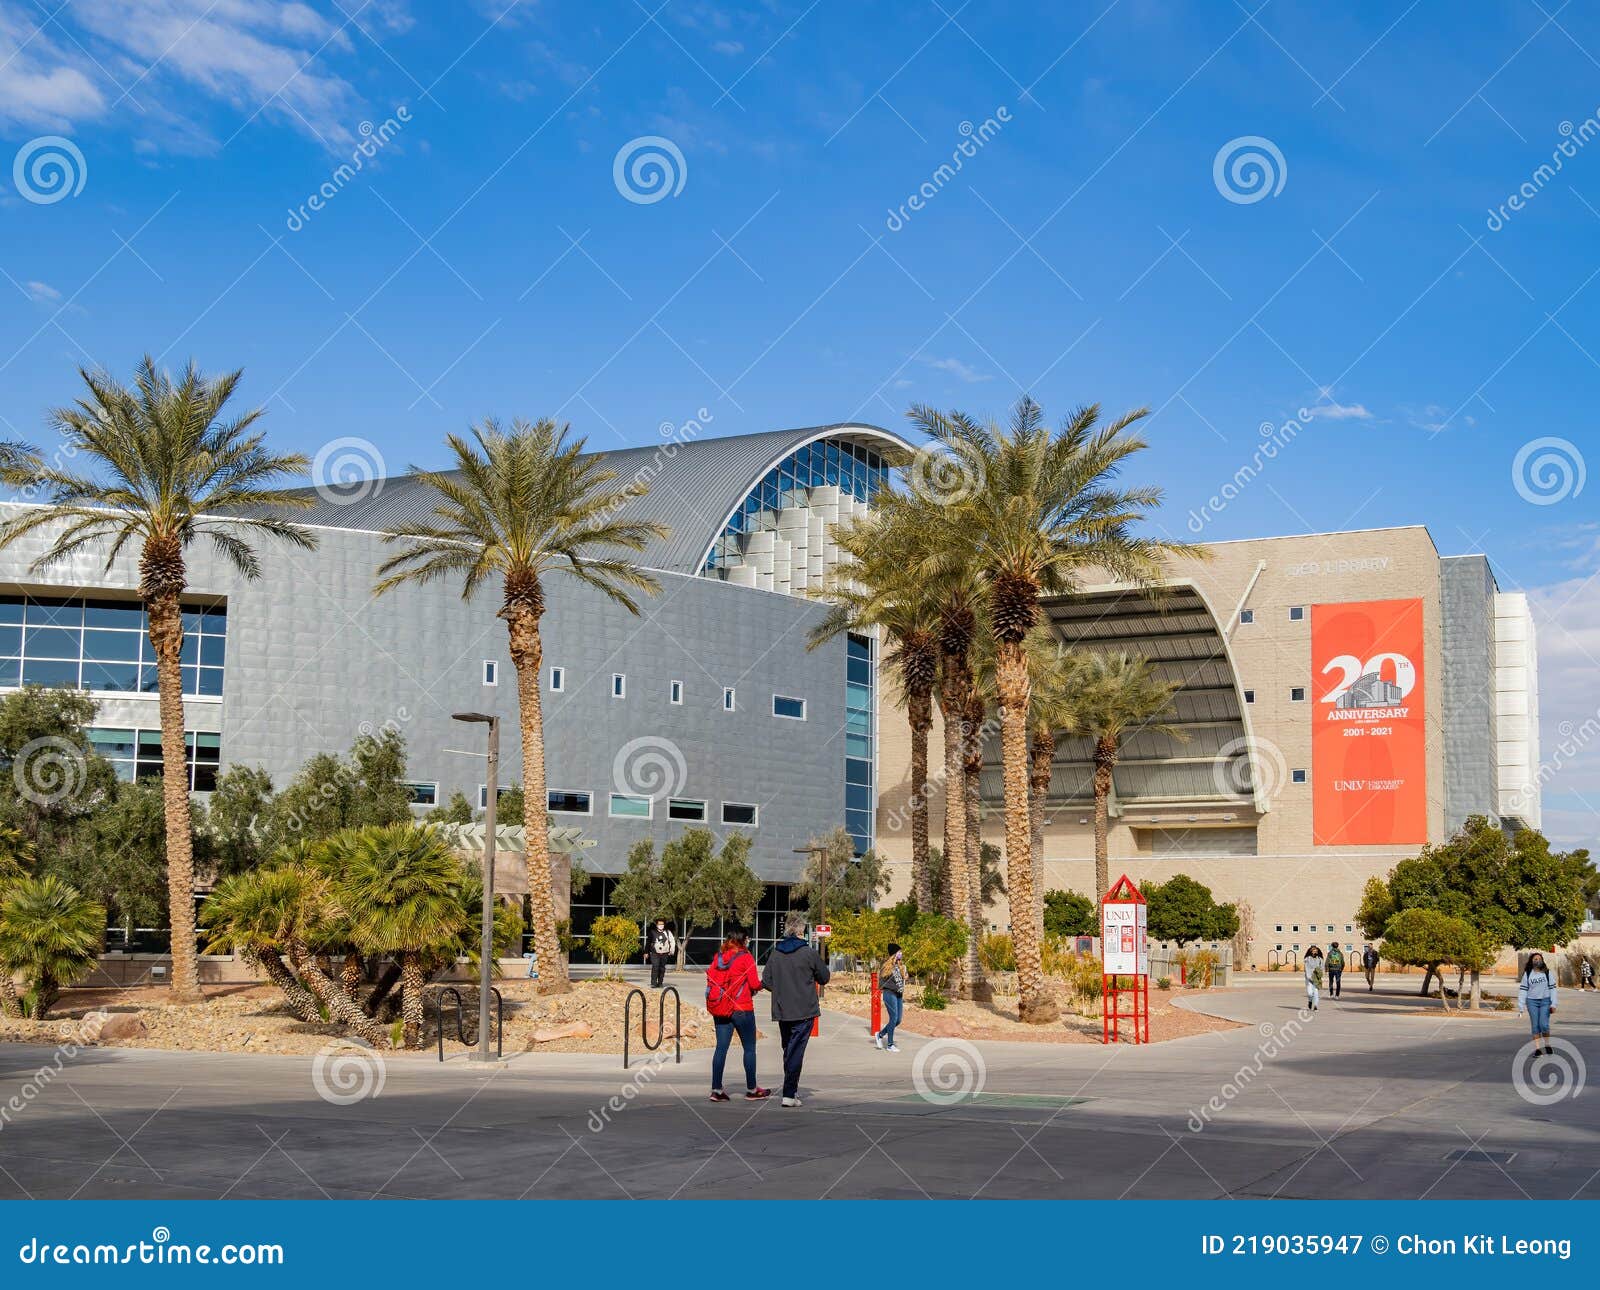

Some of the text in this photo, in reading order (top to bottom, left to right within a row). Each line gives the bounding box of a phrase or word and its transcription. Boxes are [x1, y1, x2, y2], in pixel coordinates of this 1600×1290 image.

[1324, 557, 1389, 574] LIBRARY
[1321, 652, 1416, 703] 20
[1327, 708, 1409, 721] ANNIVERSARY
[1106, 911, 1133, 920] UNLV
